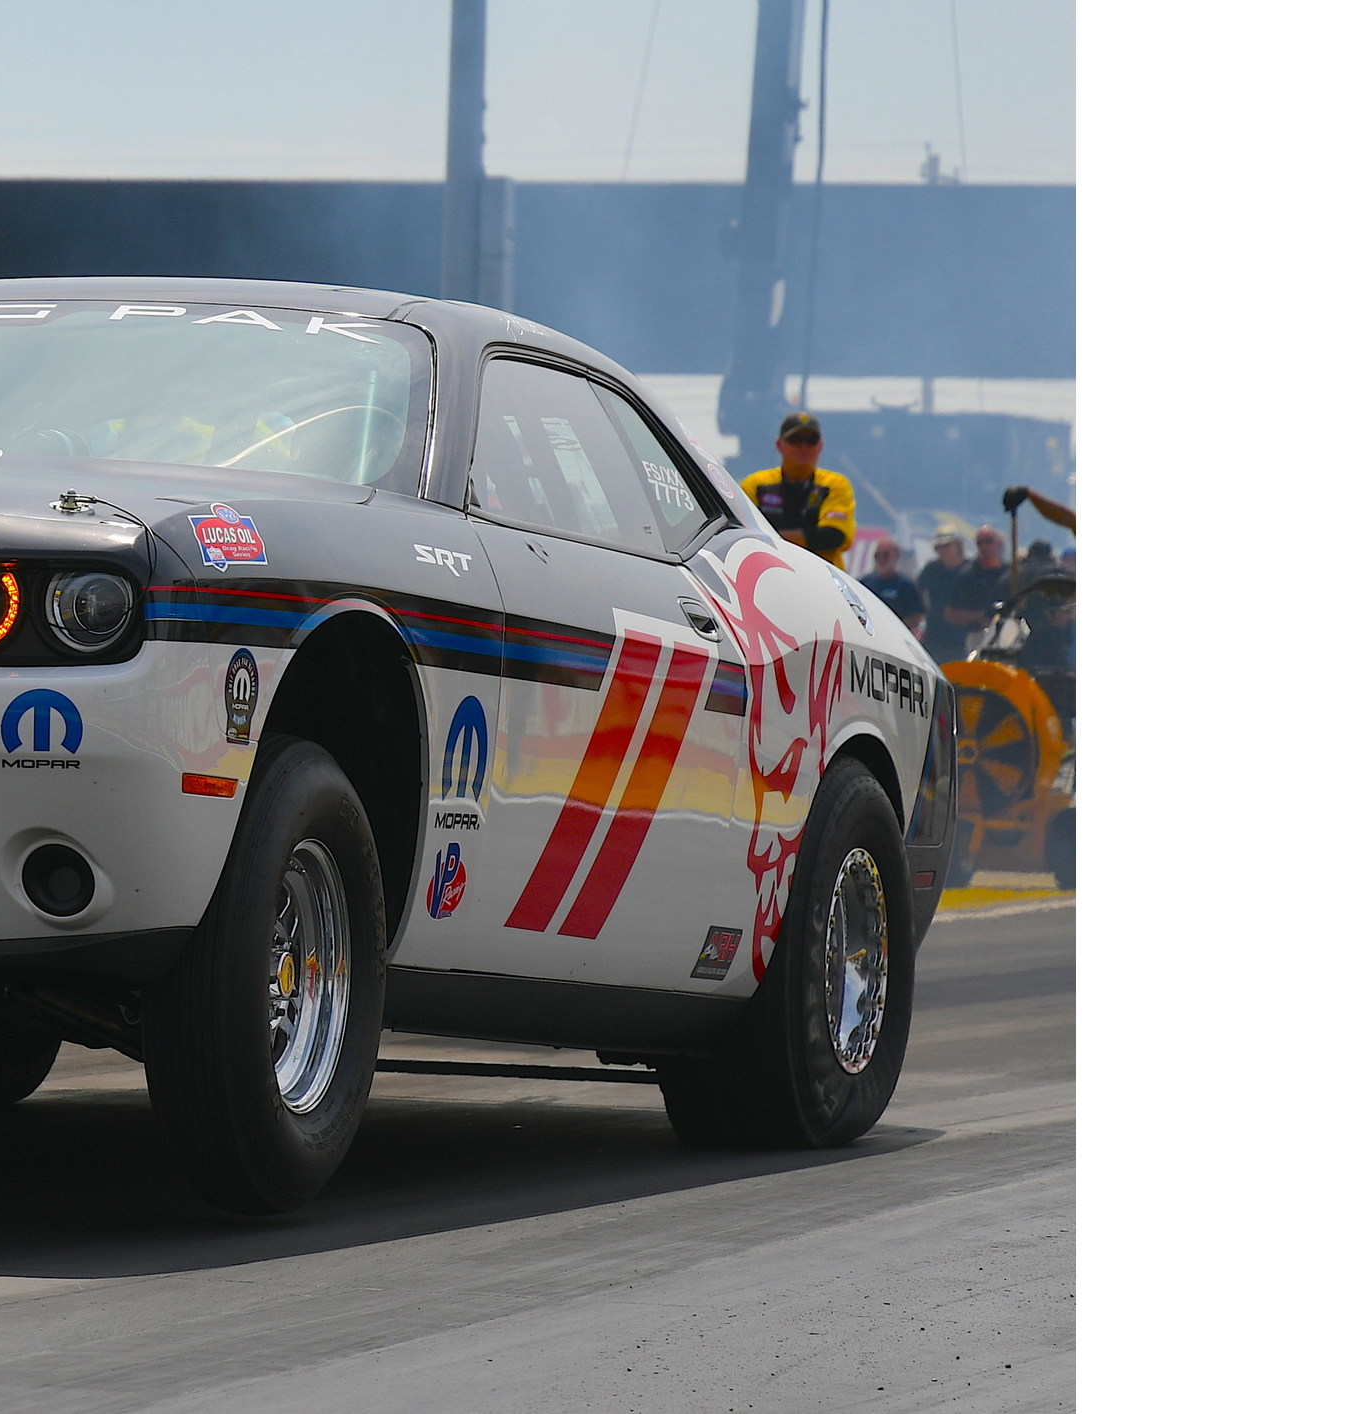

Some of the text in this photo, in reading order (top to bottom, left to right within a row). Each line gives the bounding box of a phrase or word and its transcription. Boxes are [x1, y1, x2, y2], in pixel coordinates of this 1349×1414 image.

[108, 304, 382, 345] PAK
[642, 460, 684, 488] FS/XX
[648, 479, 695, 511] 7773
[201, 527, 256, 544] LUCAS OIL
[413, 543, 473, 577] SRT
[850, 650, 925, 717] MOPAR
[1, 759, 81, 769] MOPAR
[434, 812, 479, 830] MOPAR
[430, 842, 461, 919] VP
[710, 932, 742, 962] ARH
